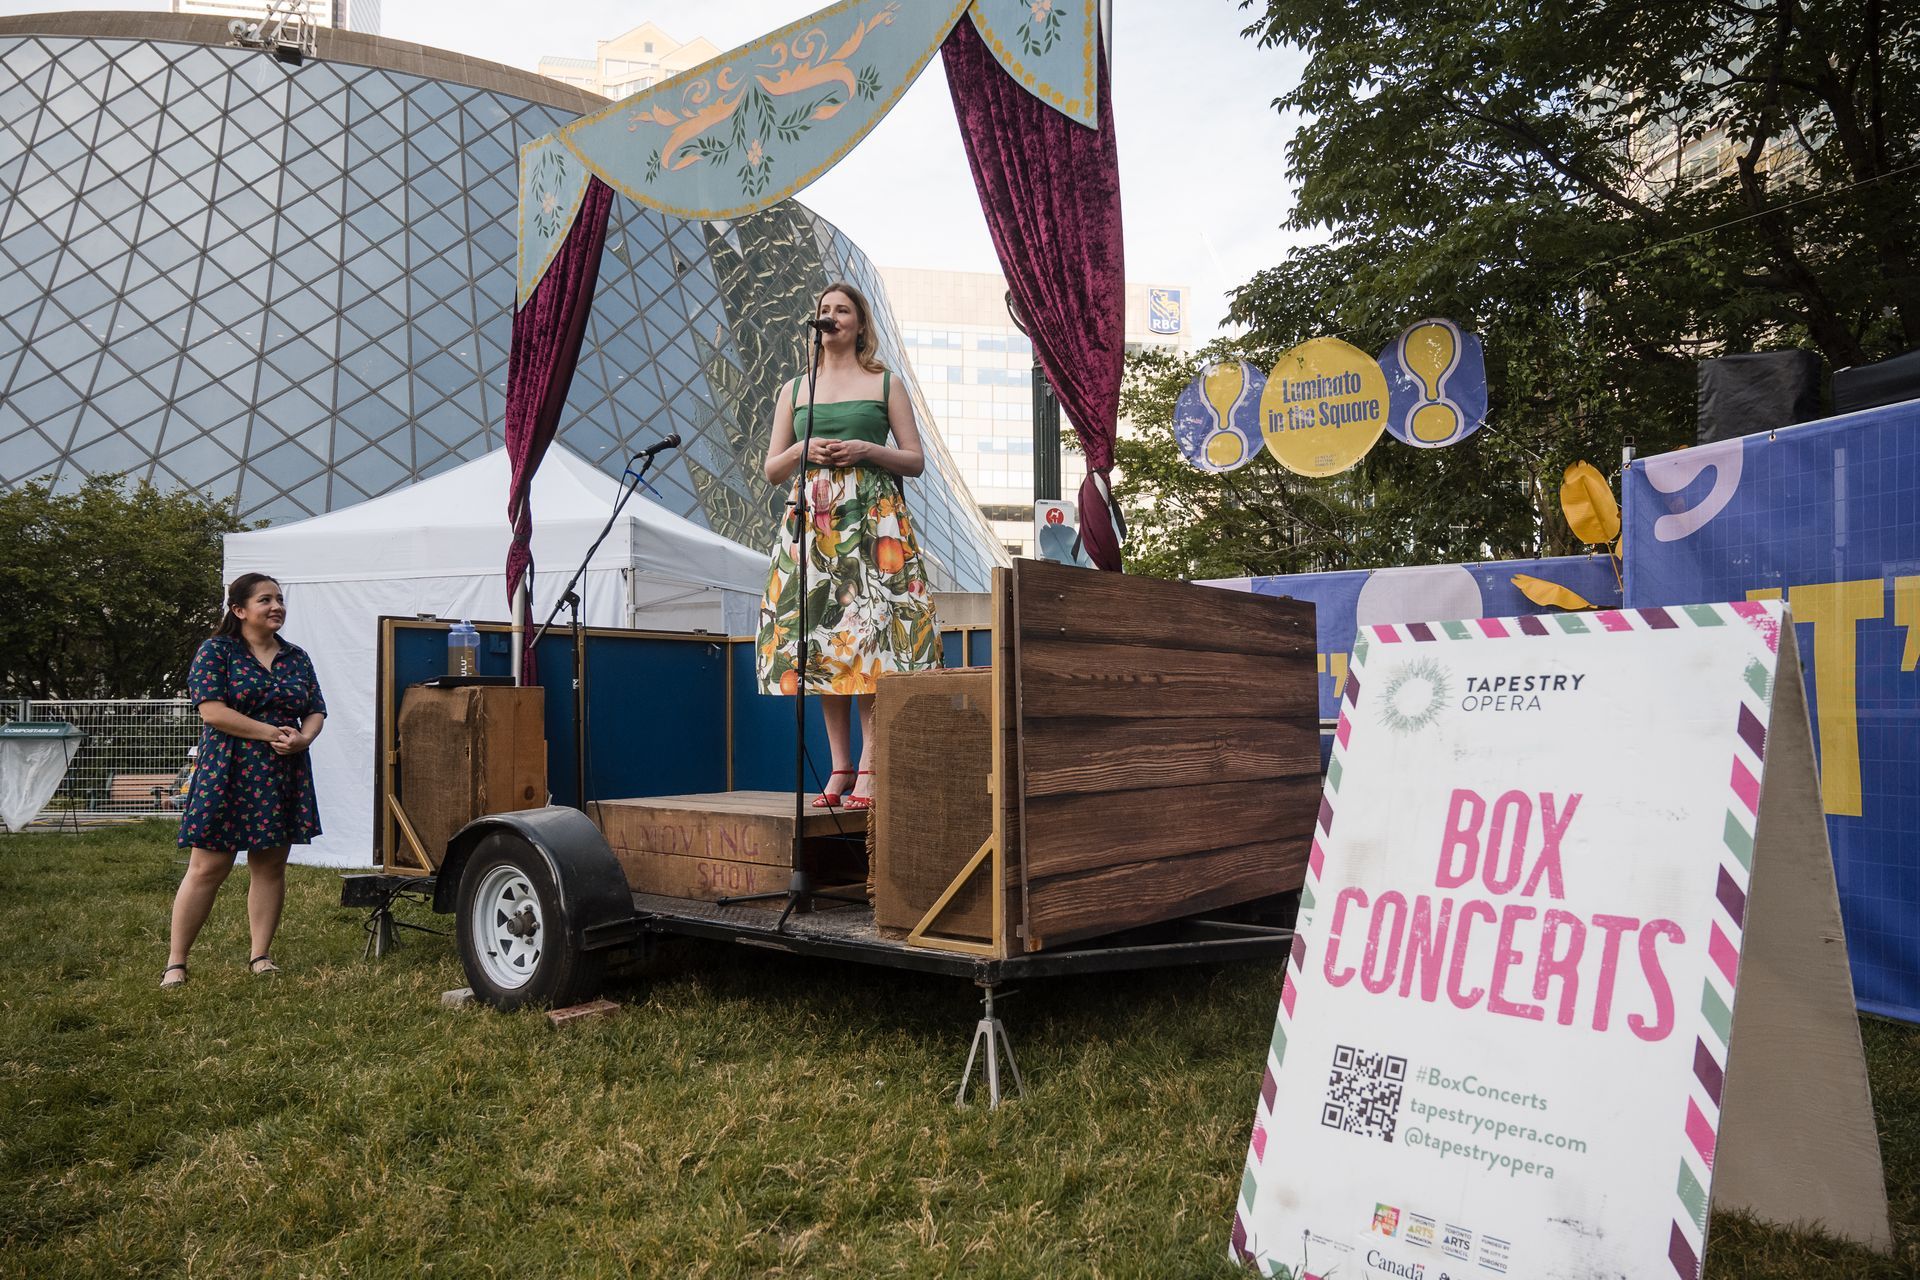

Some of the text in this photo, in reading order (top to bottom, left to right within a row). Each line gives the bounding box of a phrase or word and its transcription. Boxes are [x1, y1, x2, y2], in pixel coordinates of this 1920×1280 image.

[1152, 318, 1179, 331] RBC
[1282, 371, 1362, 403] Luminato
[1268, 399, 1380, 433] in the Square
[1466, 674, 1586, 693] TAPESTRY
[1461, 694, 1541, 712] OPERA
[640, 824, 759, 858] MOVING
[1435, 788, 1583, 900] BOX
[697, 862, 757, 891] SHOW
[1323, 886, 1686, 1042] CONCERTS
[1415, 1064, 1548, 1112] #BoxConcerts
[1408, 1097, 1588, 1154] tapestryopera.com
[1403, 1126, 1555, 1180] @tapestryopera
[1444, 1226, 1473, 1240] TORONTO
[1366, 1249, 1424, 1280] Canada
